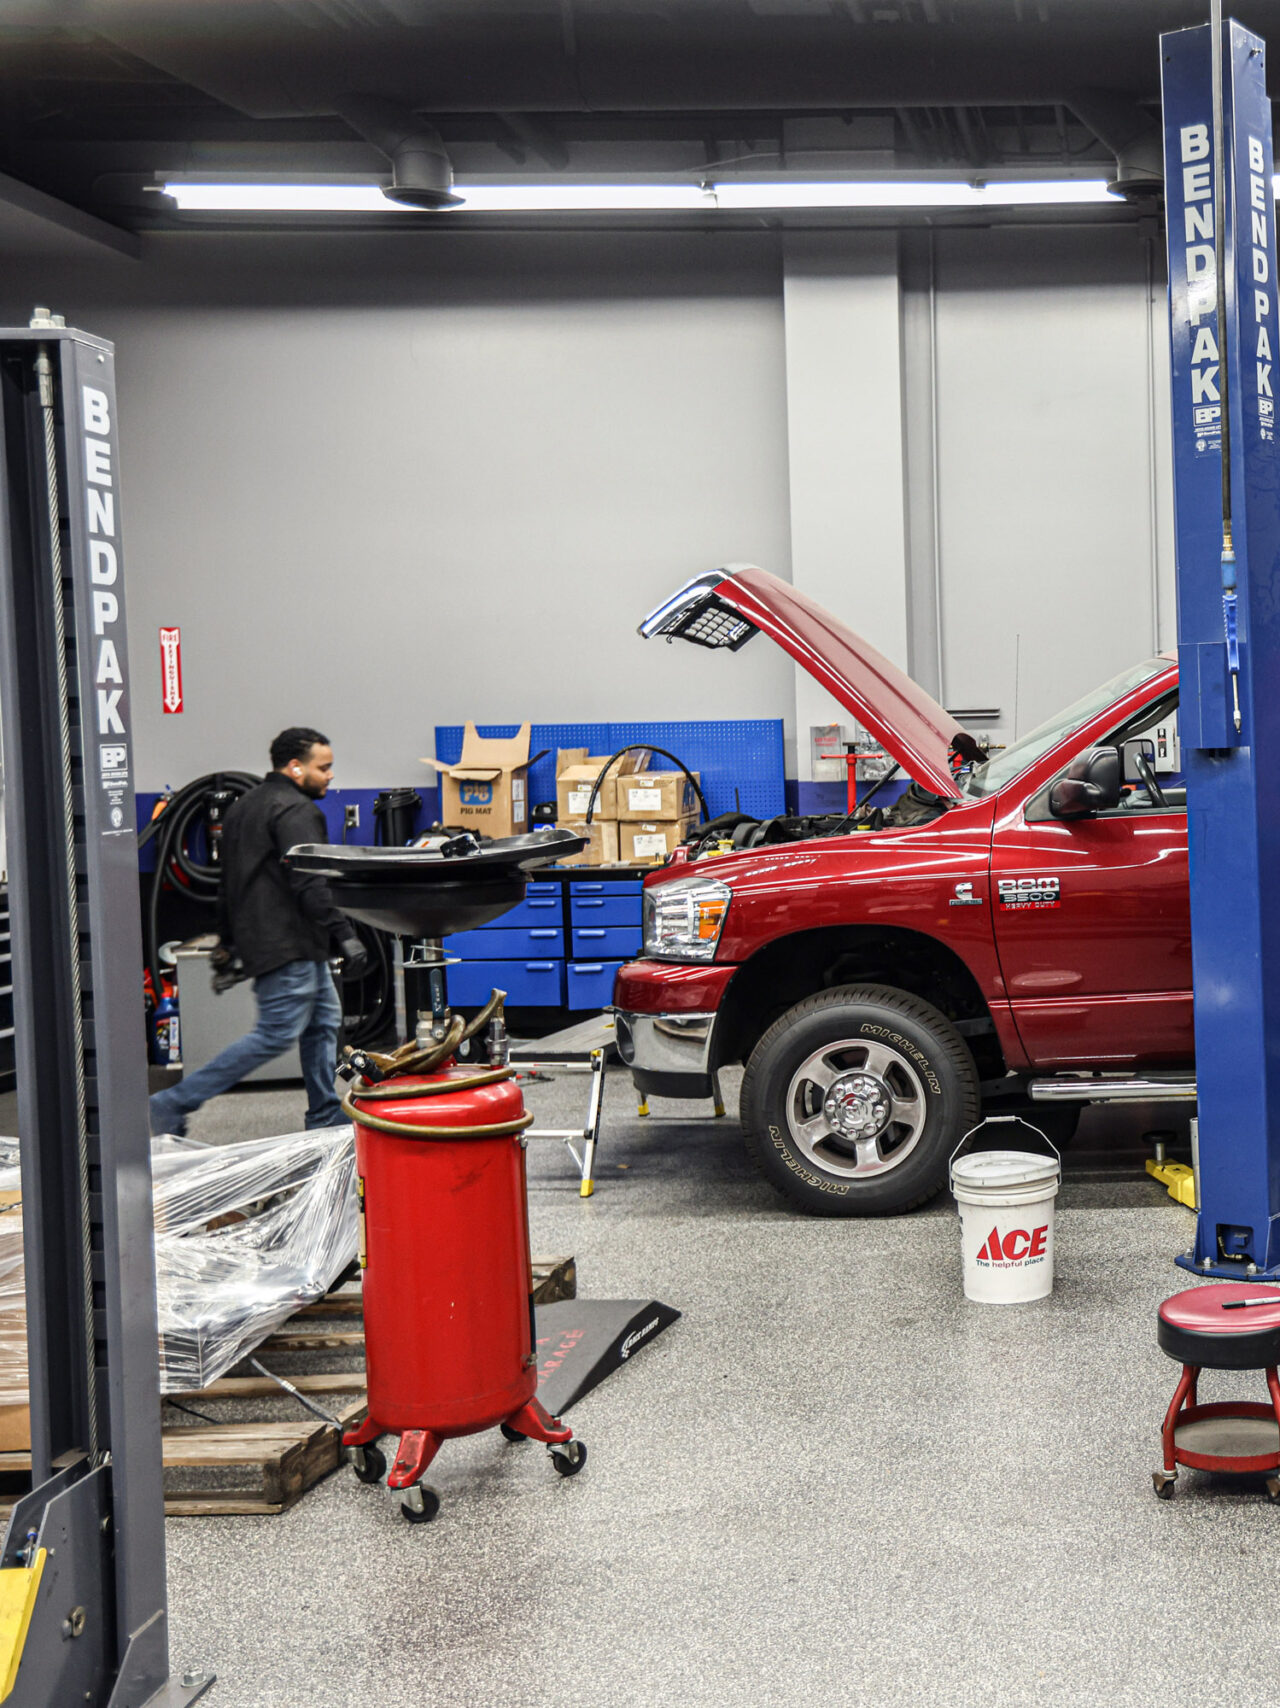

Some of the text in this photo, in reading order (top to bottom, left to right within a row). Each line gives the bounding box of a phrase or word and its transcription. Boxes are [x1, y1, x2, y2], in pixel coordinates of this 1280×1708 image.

[1180, 124, 1221, 404] BENDPAK
[1248, 136, 1273, 397] BENDPAK
[82, 386, 126, 735] BENDPAK
[460, 807, 492, 815] PIG MAT
[1003, 892, 1056, 902] 3500
[1005, 901, 1056, 910] HEAVY DUTY
[860, 1023, 942, 1095] MICHELIN
[768, 1125, 850, 1196] MICHELIN
[976, 1224, 1048, 1261] ACE
[976, 1256, 1045, 1269] The helpful place
